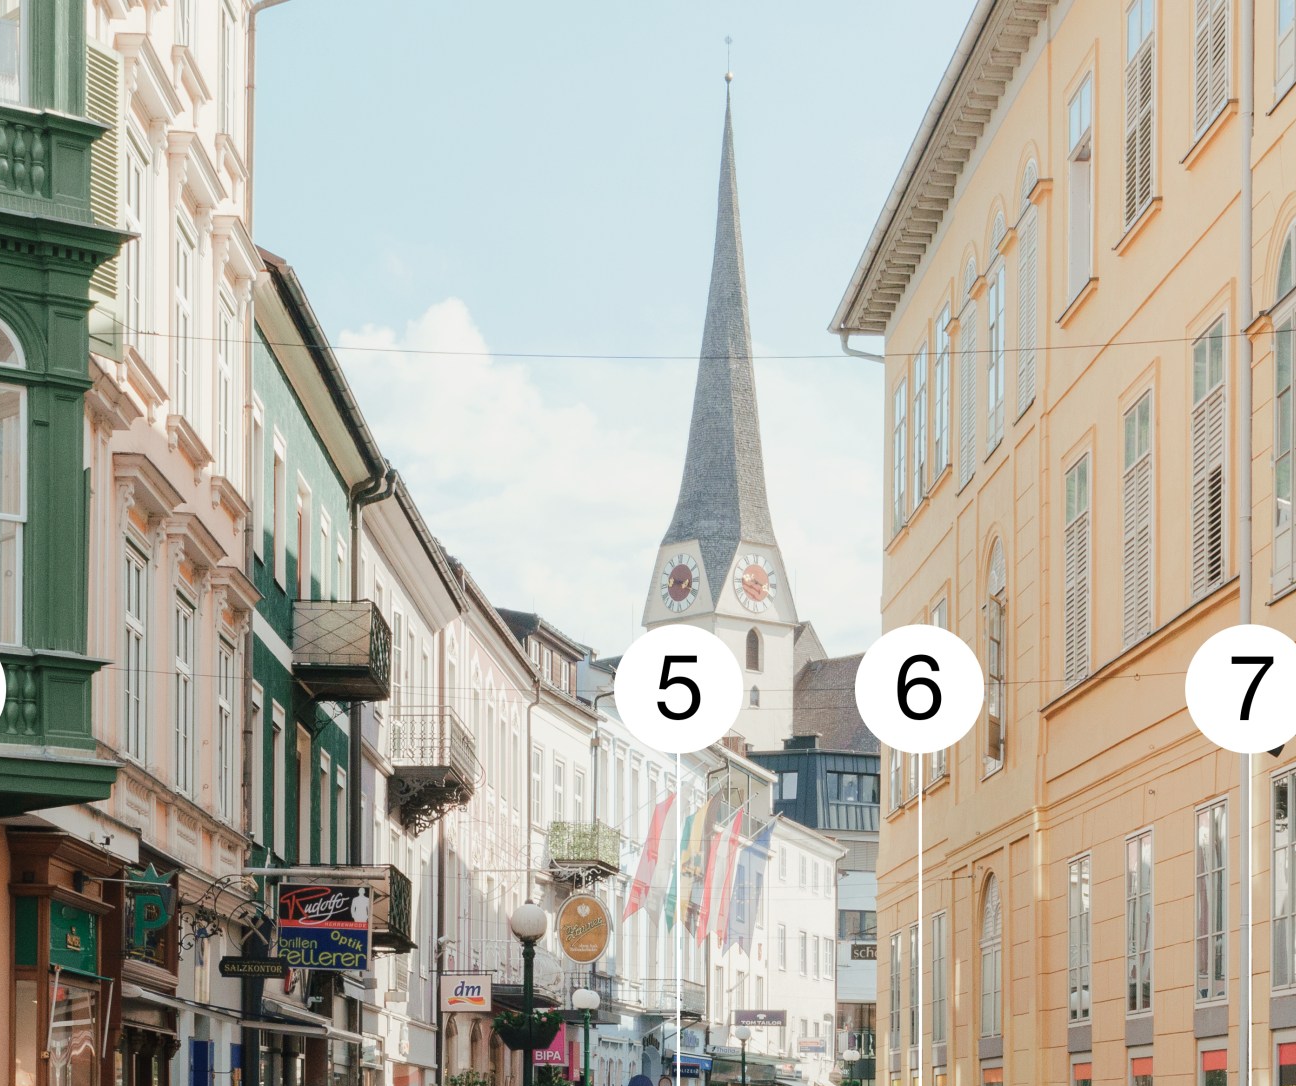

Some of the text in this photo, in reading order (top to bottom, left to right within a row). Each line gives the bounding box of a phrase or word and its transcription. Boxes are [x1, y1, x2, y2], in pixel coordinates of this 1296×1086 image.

[279, 937, 317, 949] brillen
[330, 931, 363, 952] Optik
[224, 963, 283, 974] SALZKONTOR
[454, 981, 481, 997] dm
[535, 1051, 561, 1061] BIPA
